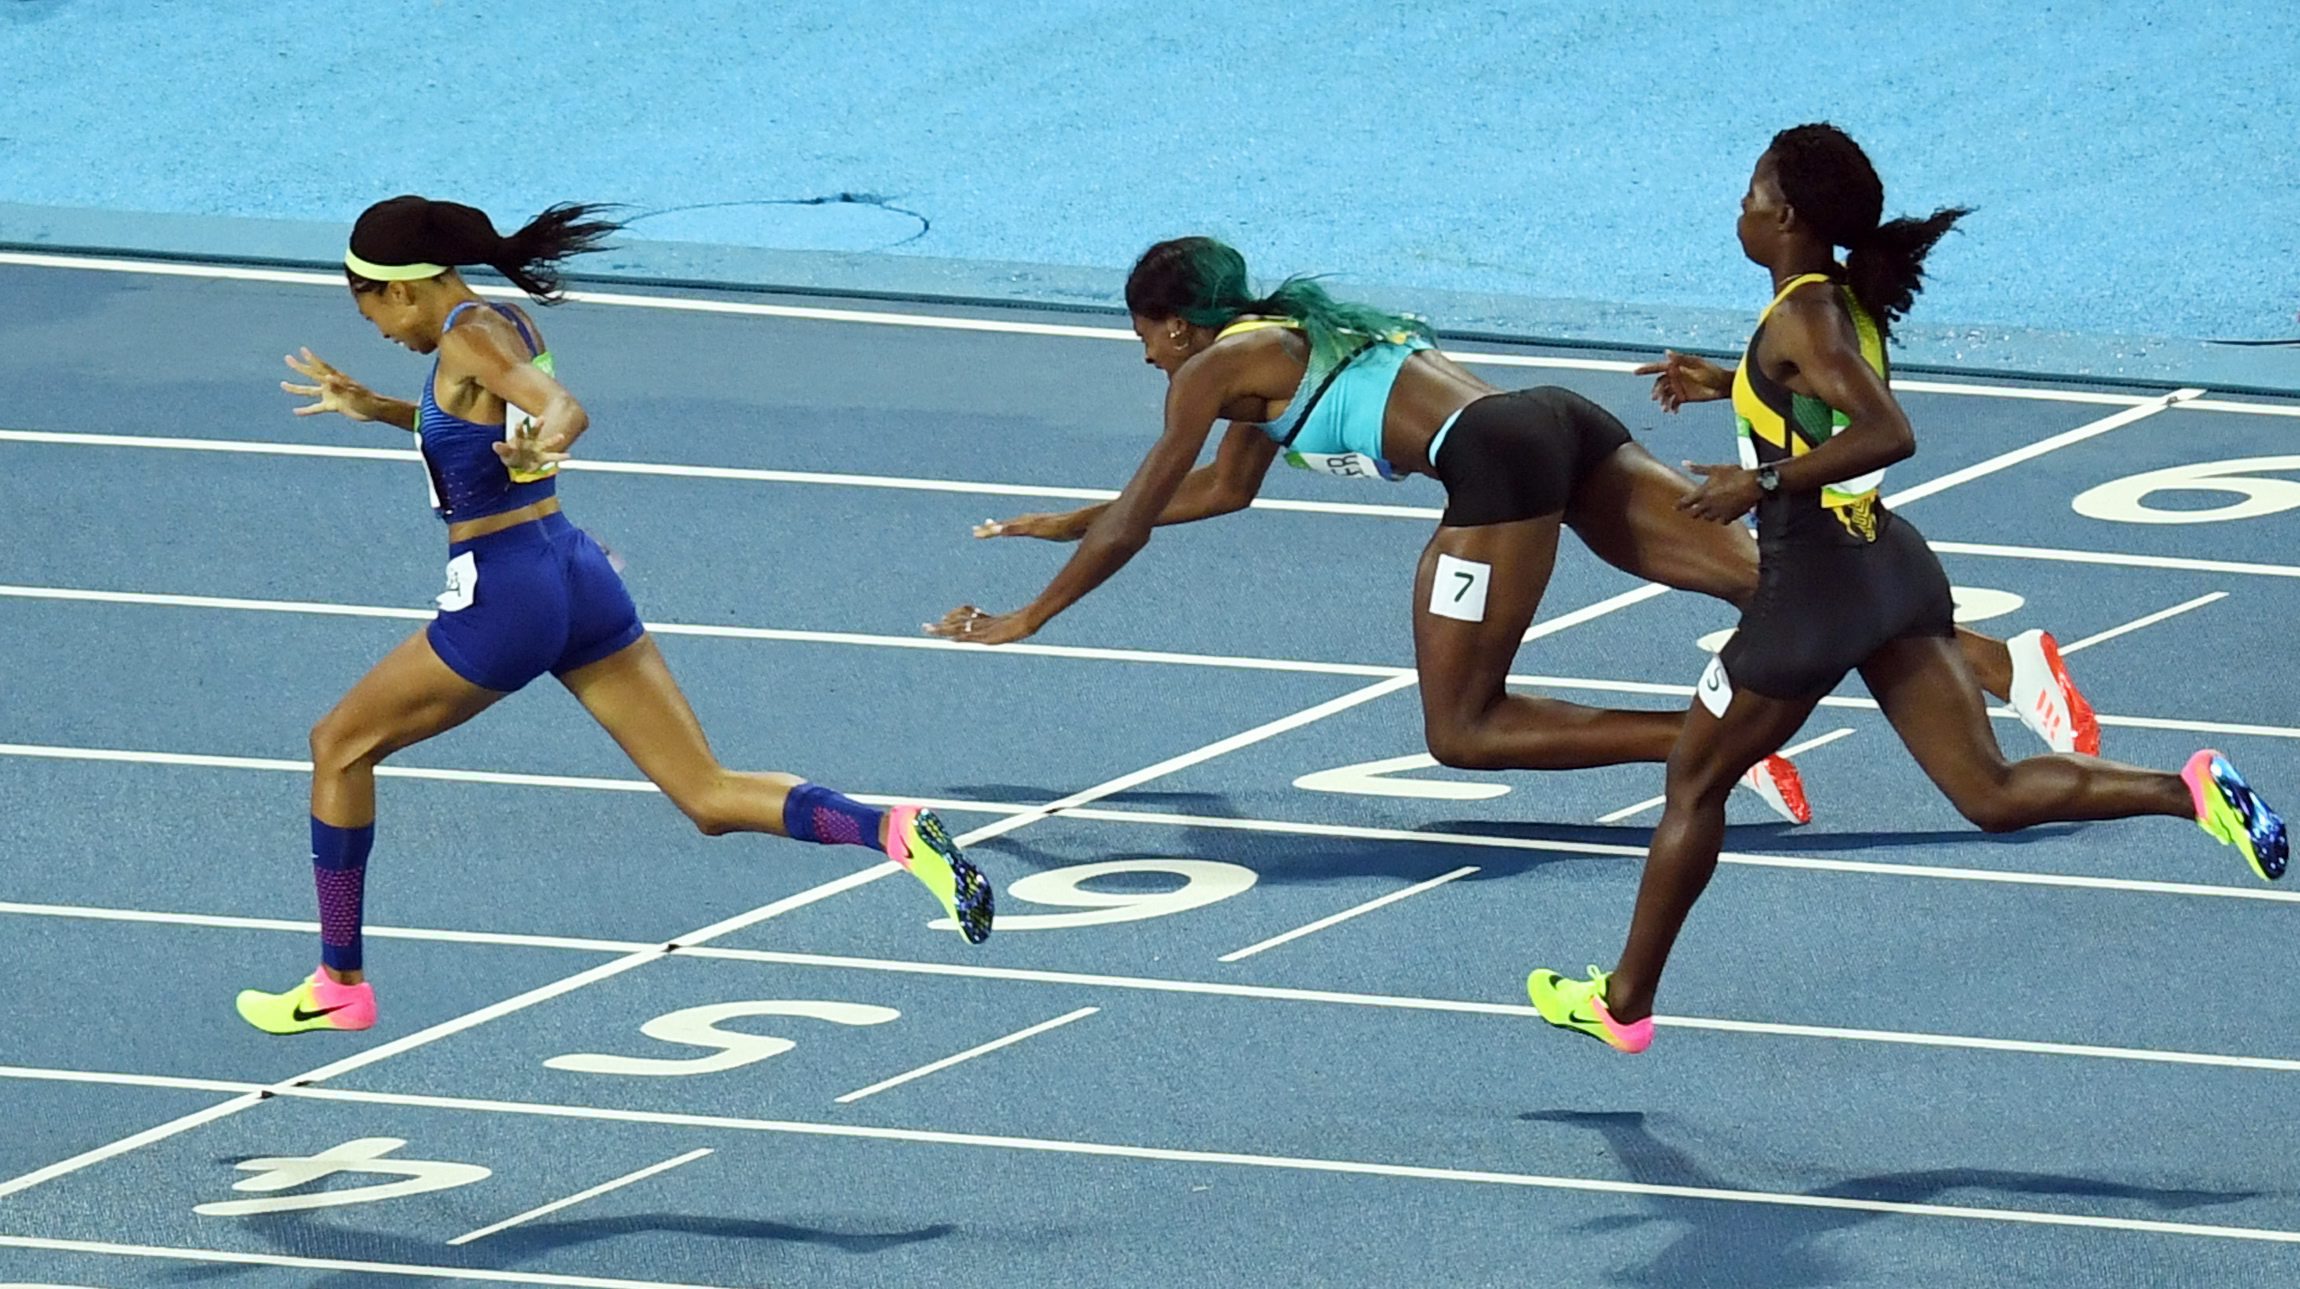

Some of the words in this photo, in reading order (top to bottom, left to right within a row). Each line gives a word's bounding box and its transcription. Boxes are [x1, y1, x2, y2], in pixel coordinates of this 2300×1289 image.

[1454, 571, 1475, 603] 7
[543, 1000, 901, 1076] 5
[192, 1137, 493, 1216] 4
